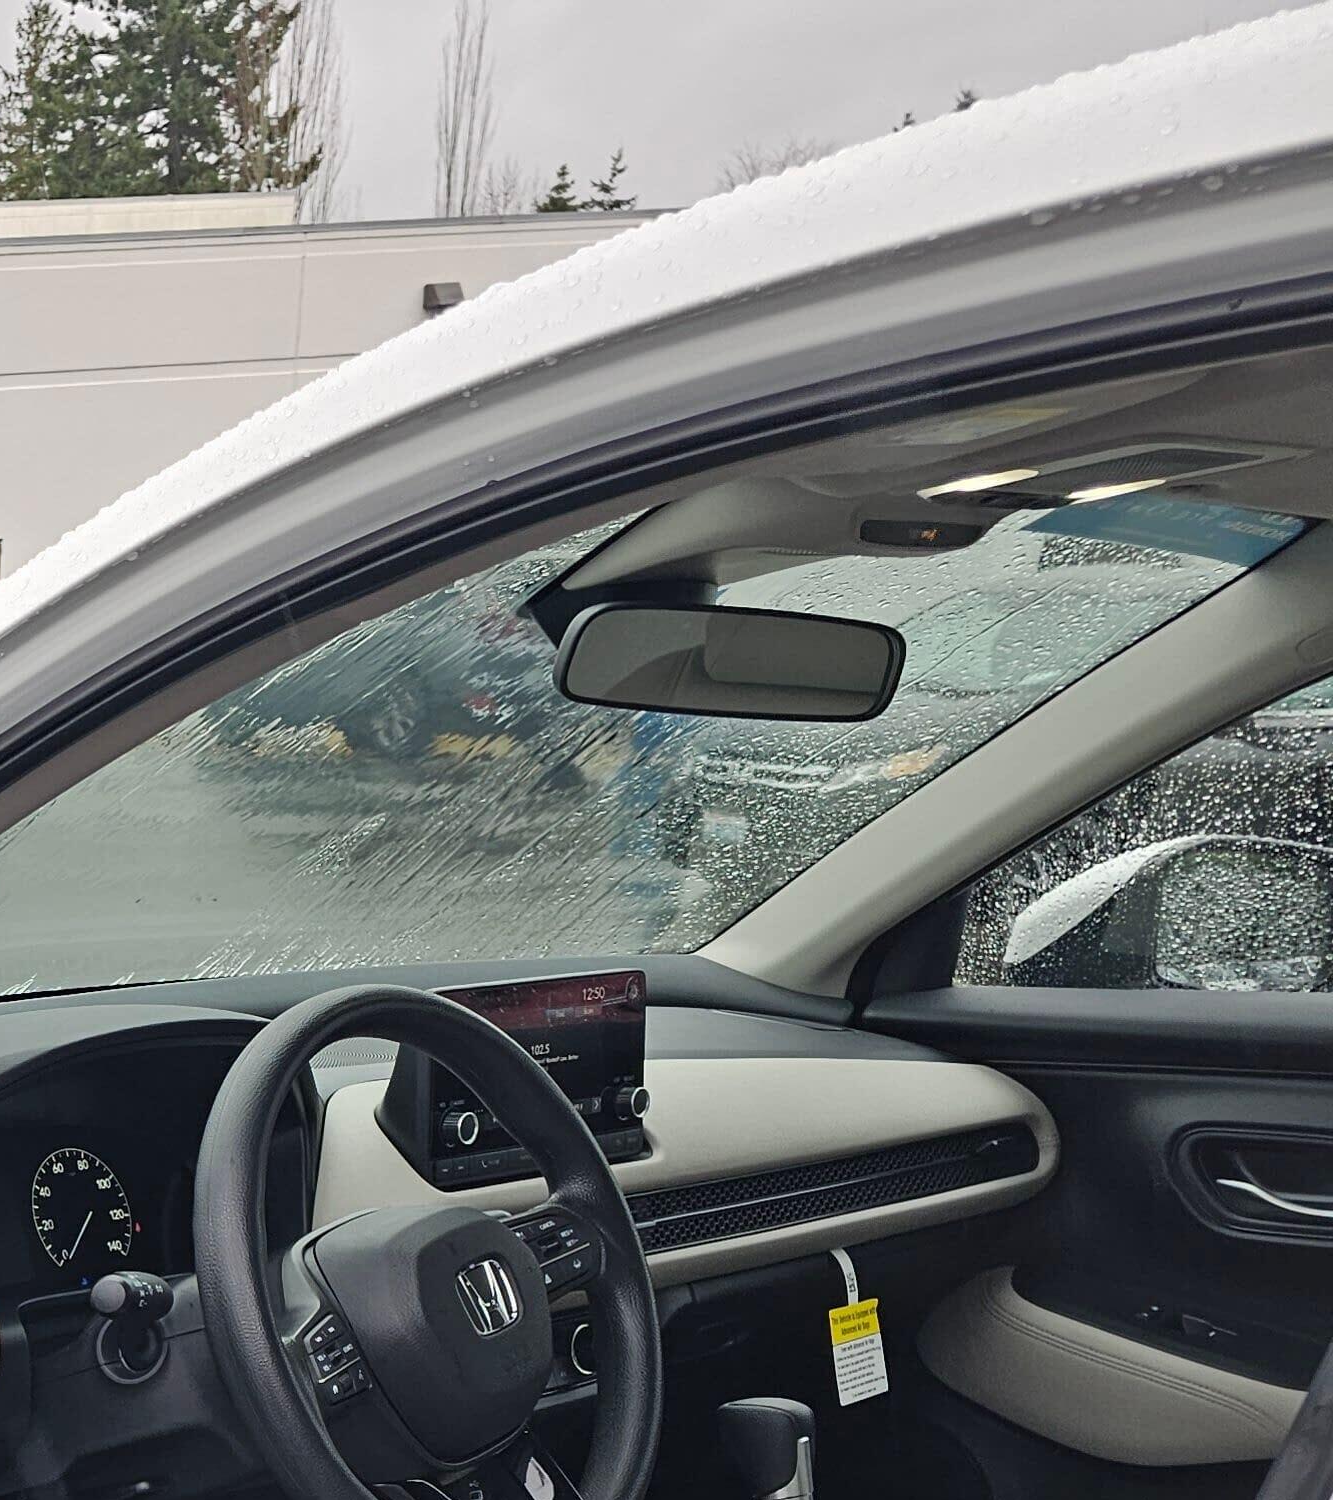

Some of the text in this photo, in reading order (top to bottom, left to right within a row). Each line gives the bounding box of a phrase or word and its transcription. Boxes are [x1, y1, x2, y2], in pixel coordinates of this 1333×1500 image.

[582, 986, 606, 1001] 12:50
[52, 1162, 64, 1174] 60
[77, 1159, 89, 1171] 80
[96, 1178, 111, 1190] 100
[39, 1186, 51, 1198] 40
[109, 1208, 125, 1220] 120
[41, 1219, 55, 1231] 20
[107, 1240, 122, 1252] 140
